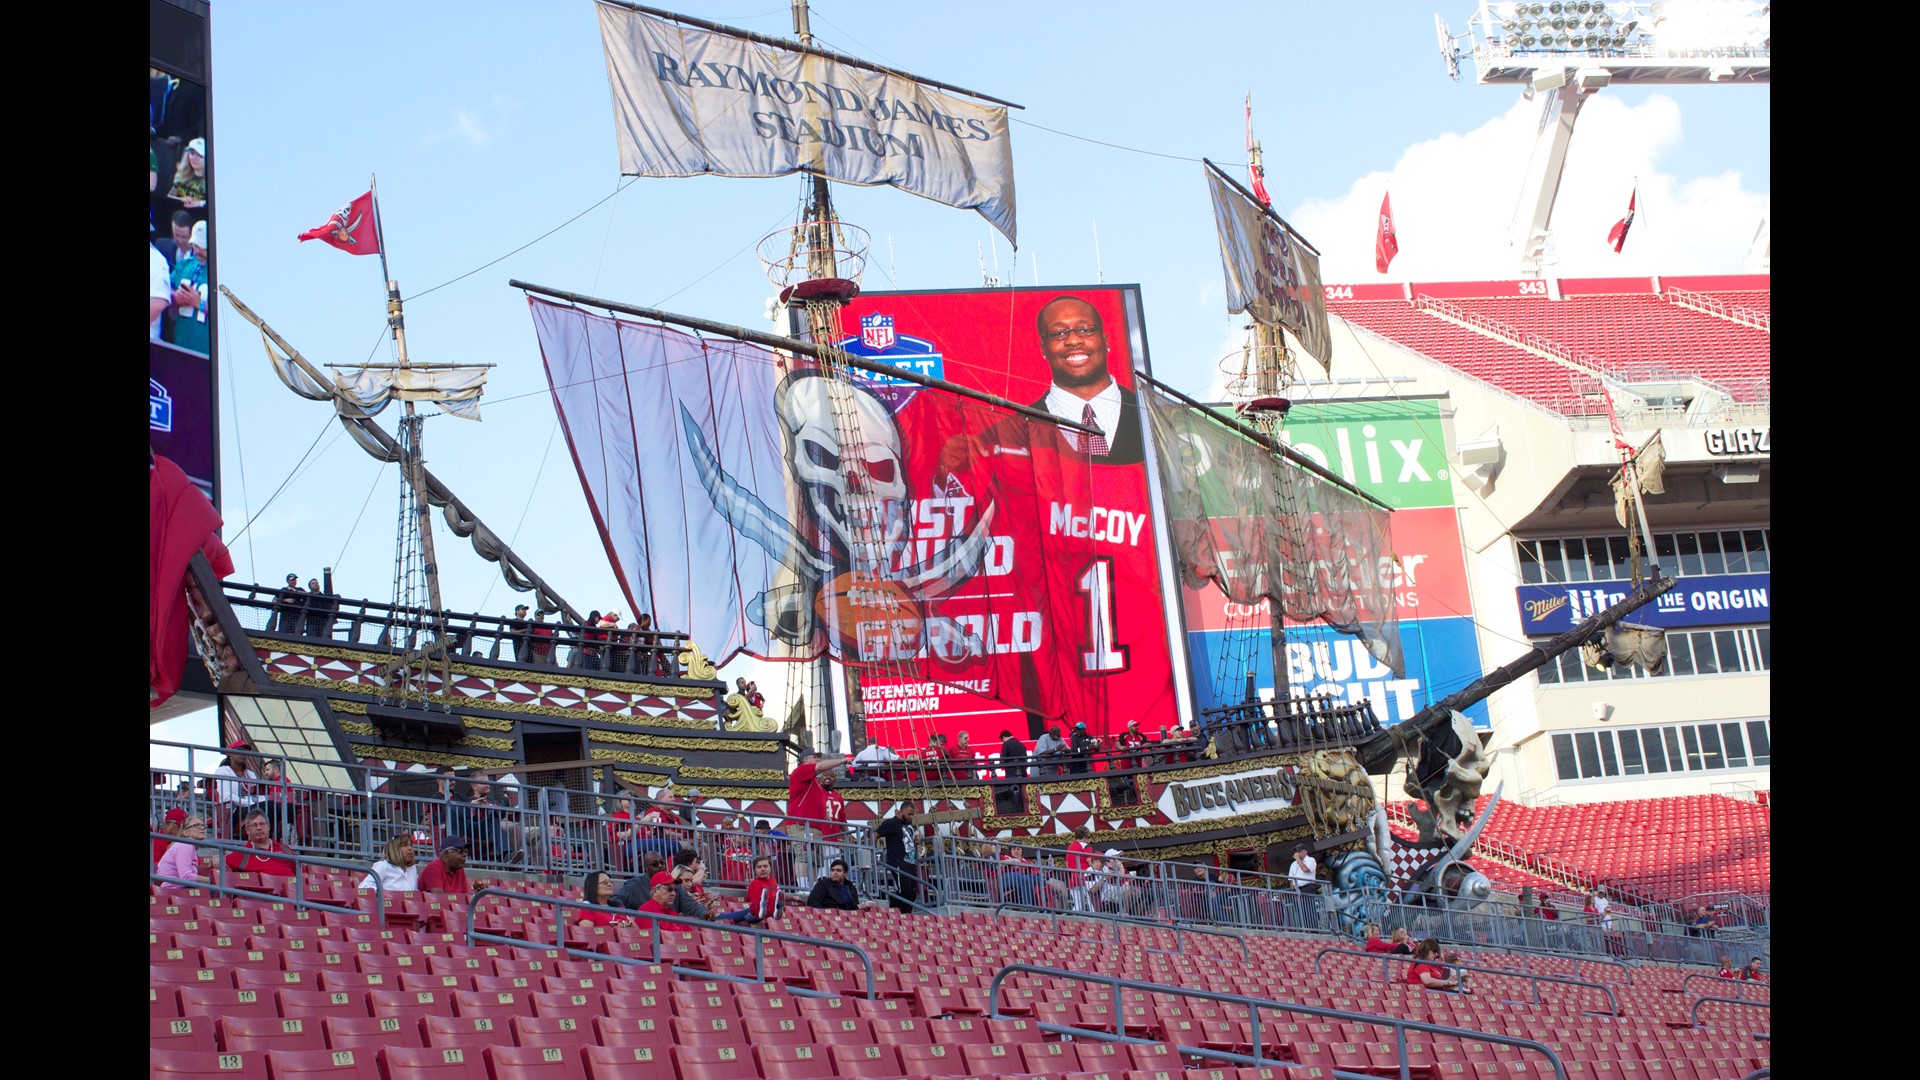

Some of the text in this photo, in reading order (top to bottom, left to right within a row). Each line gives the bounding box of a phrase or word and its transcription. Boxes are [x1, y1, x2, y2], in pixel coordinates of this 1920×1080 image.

[652, 51, 991, 142] RAYMOND JAMES
[753, 111, 926, 160] STADIUM
[1325, 286, 1353, 300] 344
[1518, 281, 1546, 294] 343
[864, 328, 893, 346] NFL
[1704, 428, 1770, 455] GLAZ
[1166, 424, 1431, 492] Pblix
[1050, 501, 1146, 546] McCOY
[1524, 595, 1568, 621] Miller
[1691, 588, 1769, 611] ORIGIN
[1077, 558, 1127, 674] 1
[855, 611, 1043, 663] GERALD
[1284, 638, 1392, 684] BUD
[1170, 769, 1293, 819] BUCCANEERS
[174, 1021, 189, 1033] 12
[286, 1020, 297, 1031] 11
[383, 1019, 396, 1031] 10
[223, 1055, 238, 1067] 13
[335, 1052, 349, 1065] 12
[447, 1050, 458, 1062] 11
[546, 1049, 558, 1060] 10
